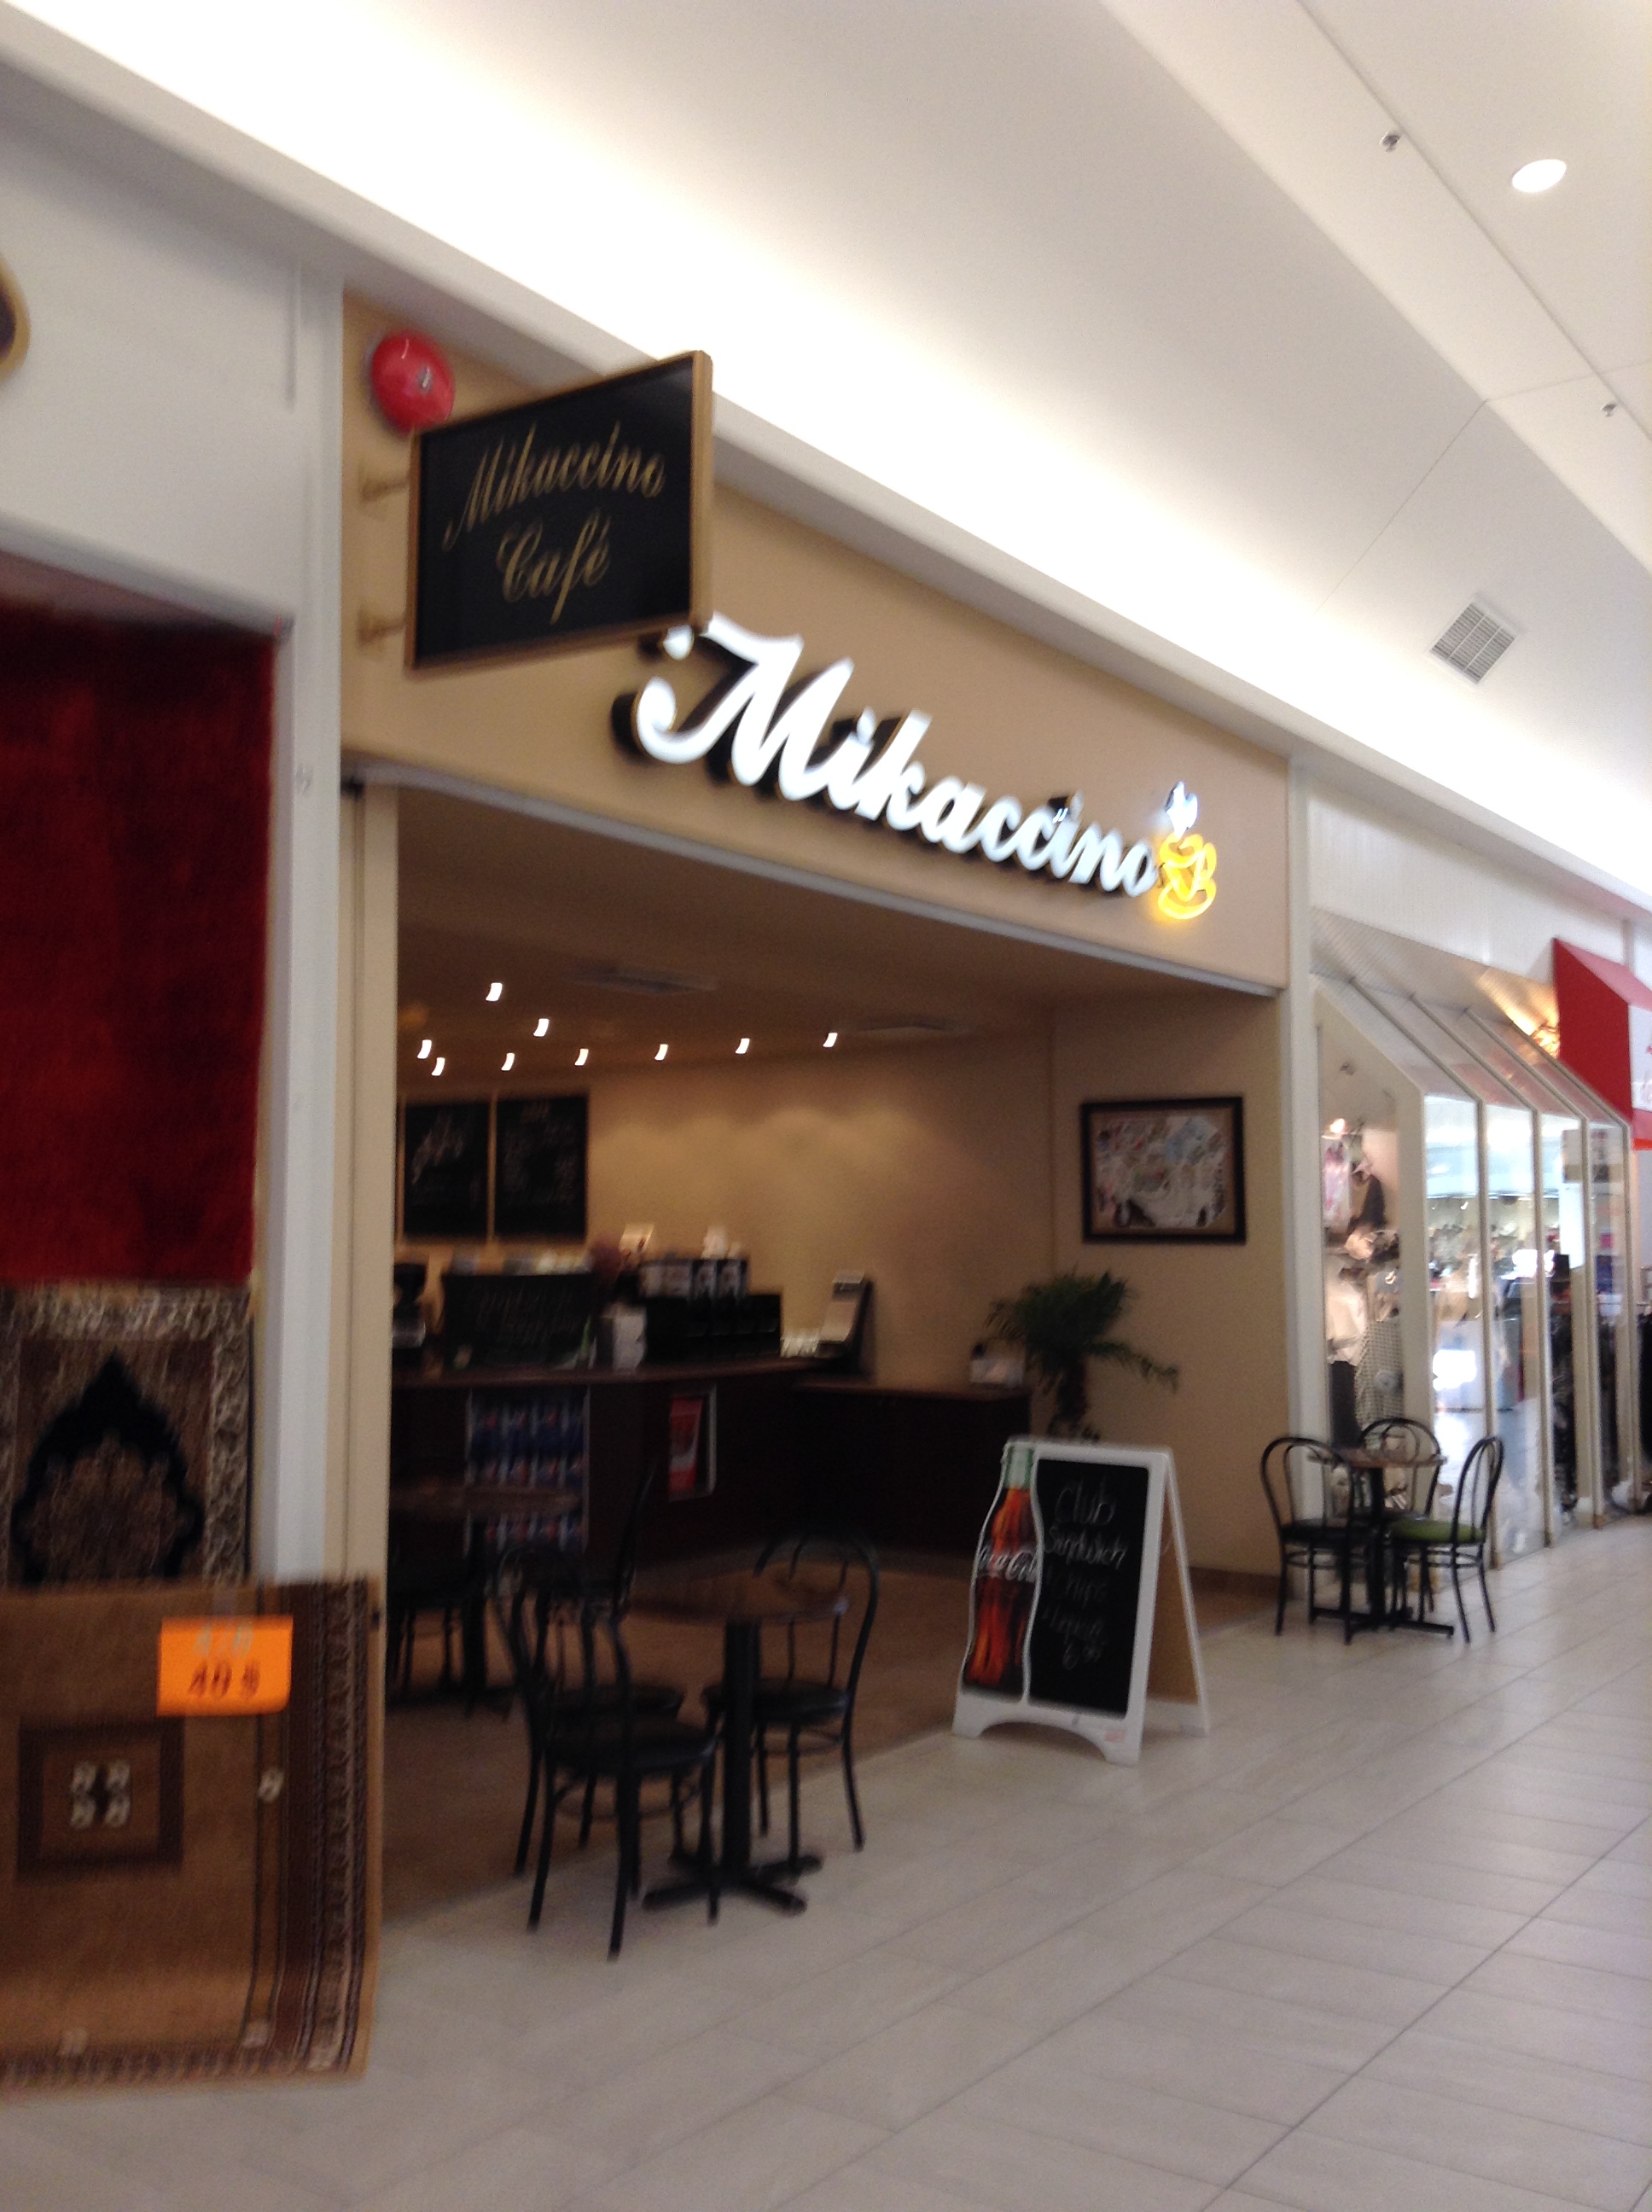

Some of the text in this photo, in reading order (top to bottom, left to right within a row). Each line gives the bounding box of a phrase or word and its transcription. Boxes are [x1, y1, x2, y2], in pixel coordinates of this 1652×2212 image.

[442, 421, 665, 551] Mikaccino
[496, 509, 611, 625] Café
[637, 611, 1157, 898] Mikaccino
